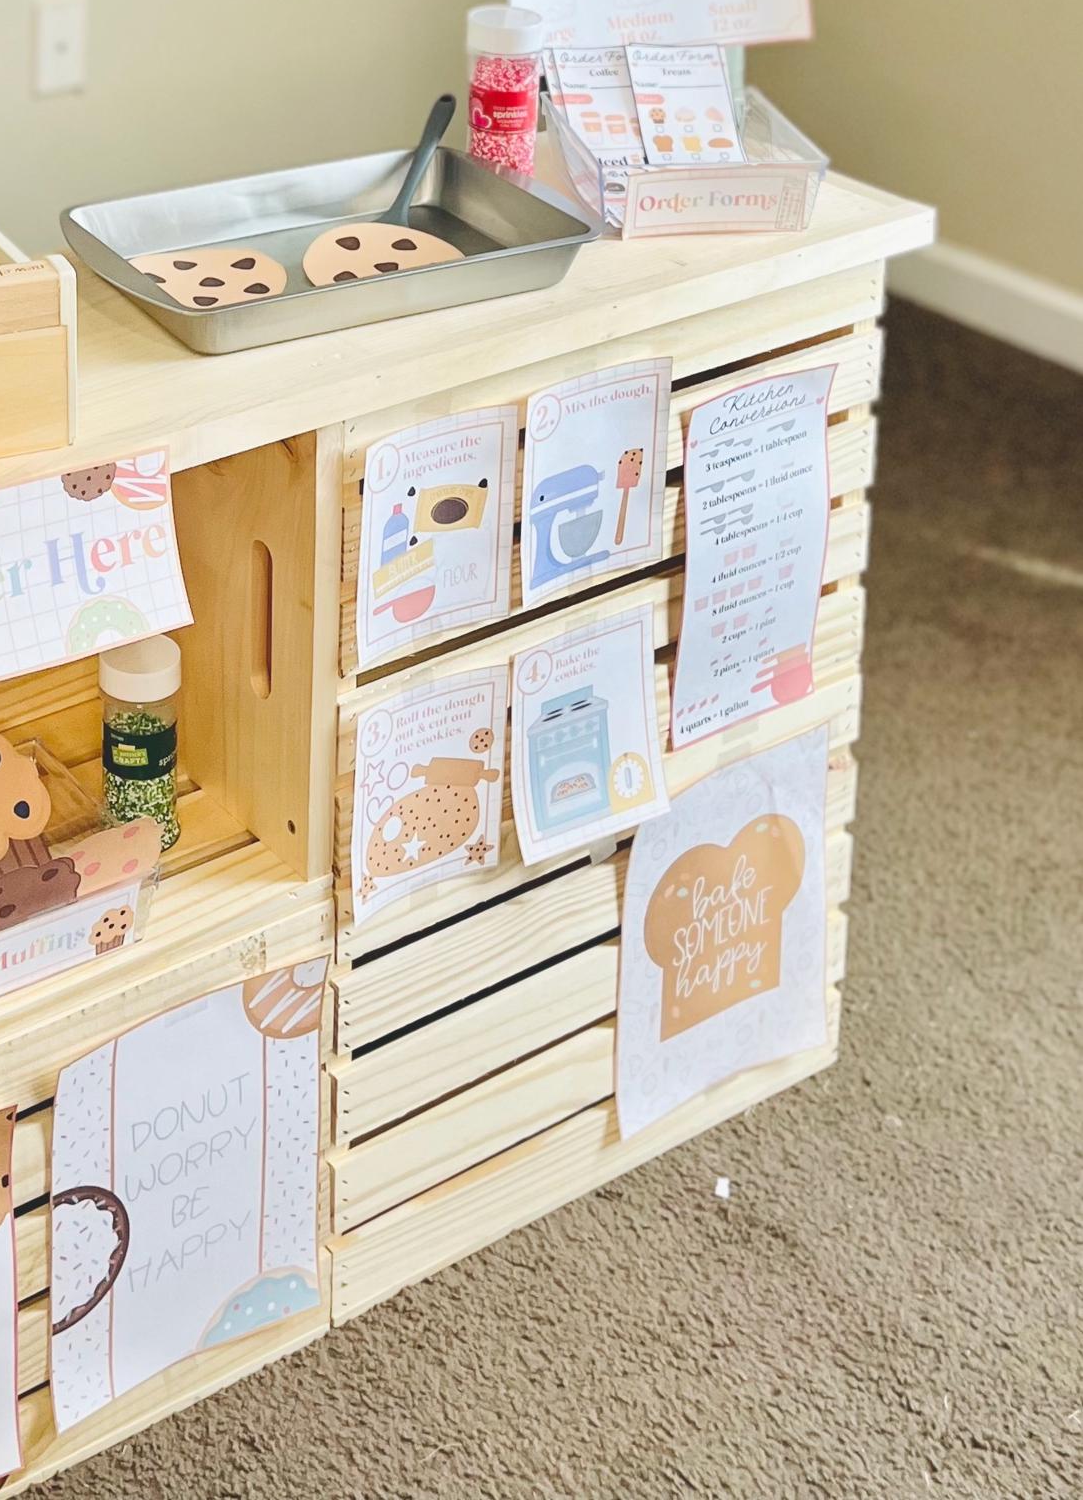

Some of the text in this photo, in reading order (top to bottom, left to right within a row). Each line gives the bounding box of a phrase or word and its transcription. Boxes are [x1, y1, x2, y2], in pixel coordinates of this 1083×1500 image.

[605, 10, 675, 30] Medium
[708, 0, 758, 15] Small
[712, 17, 730, 34] 12
[639, 193, 708, 214] Order
[708, 190, 778, 211] Forms
[565, 400, 588, 415] Mix
[589, 393, 609, 409] the
[709, 394, 806, 435] Conversions
[723, 383, 794, 414] Kitchen
[405, 443, 457, 463] Measure
[460, 436, 482, 448] the
[705, 463, 711, 473] 3
[712, 450, 753, 470] teaspoons
[765, 430, 807, 451] tablespoon
[403, 452, 477, 480] ingredients.
[42, 523, 168, 595] Here
[442, 562, 478, 588] FLOUR
[556, 653, 581, 670] Bake
[583, 647, 600, 659] the
[396, 711, 418, 729] Roll
[422, 706, 442, 719] the
[444, 693, 485, 711] dough
[396, 710, 472, 742] out & cut out
[395, 743, 414, 756] the
[692, 854, 757, 921] bake
[672, 885, 774, 967] SOMEONE
[676, 939, 767, 999] happy
[131, 1072, 250, 1153] DONUT
[124, 1117, 257, 1202] WORRY
[171, 1186, 210, 1229] BE
[127, 1211, 251, 1292] HAPPY
